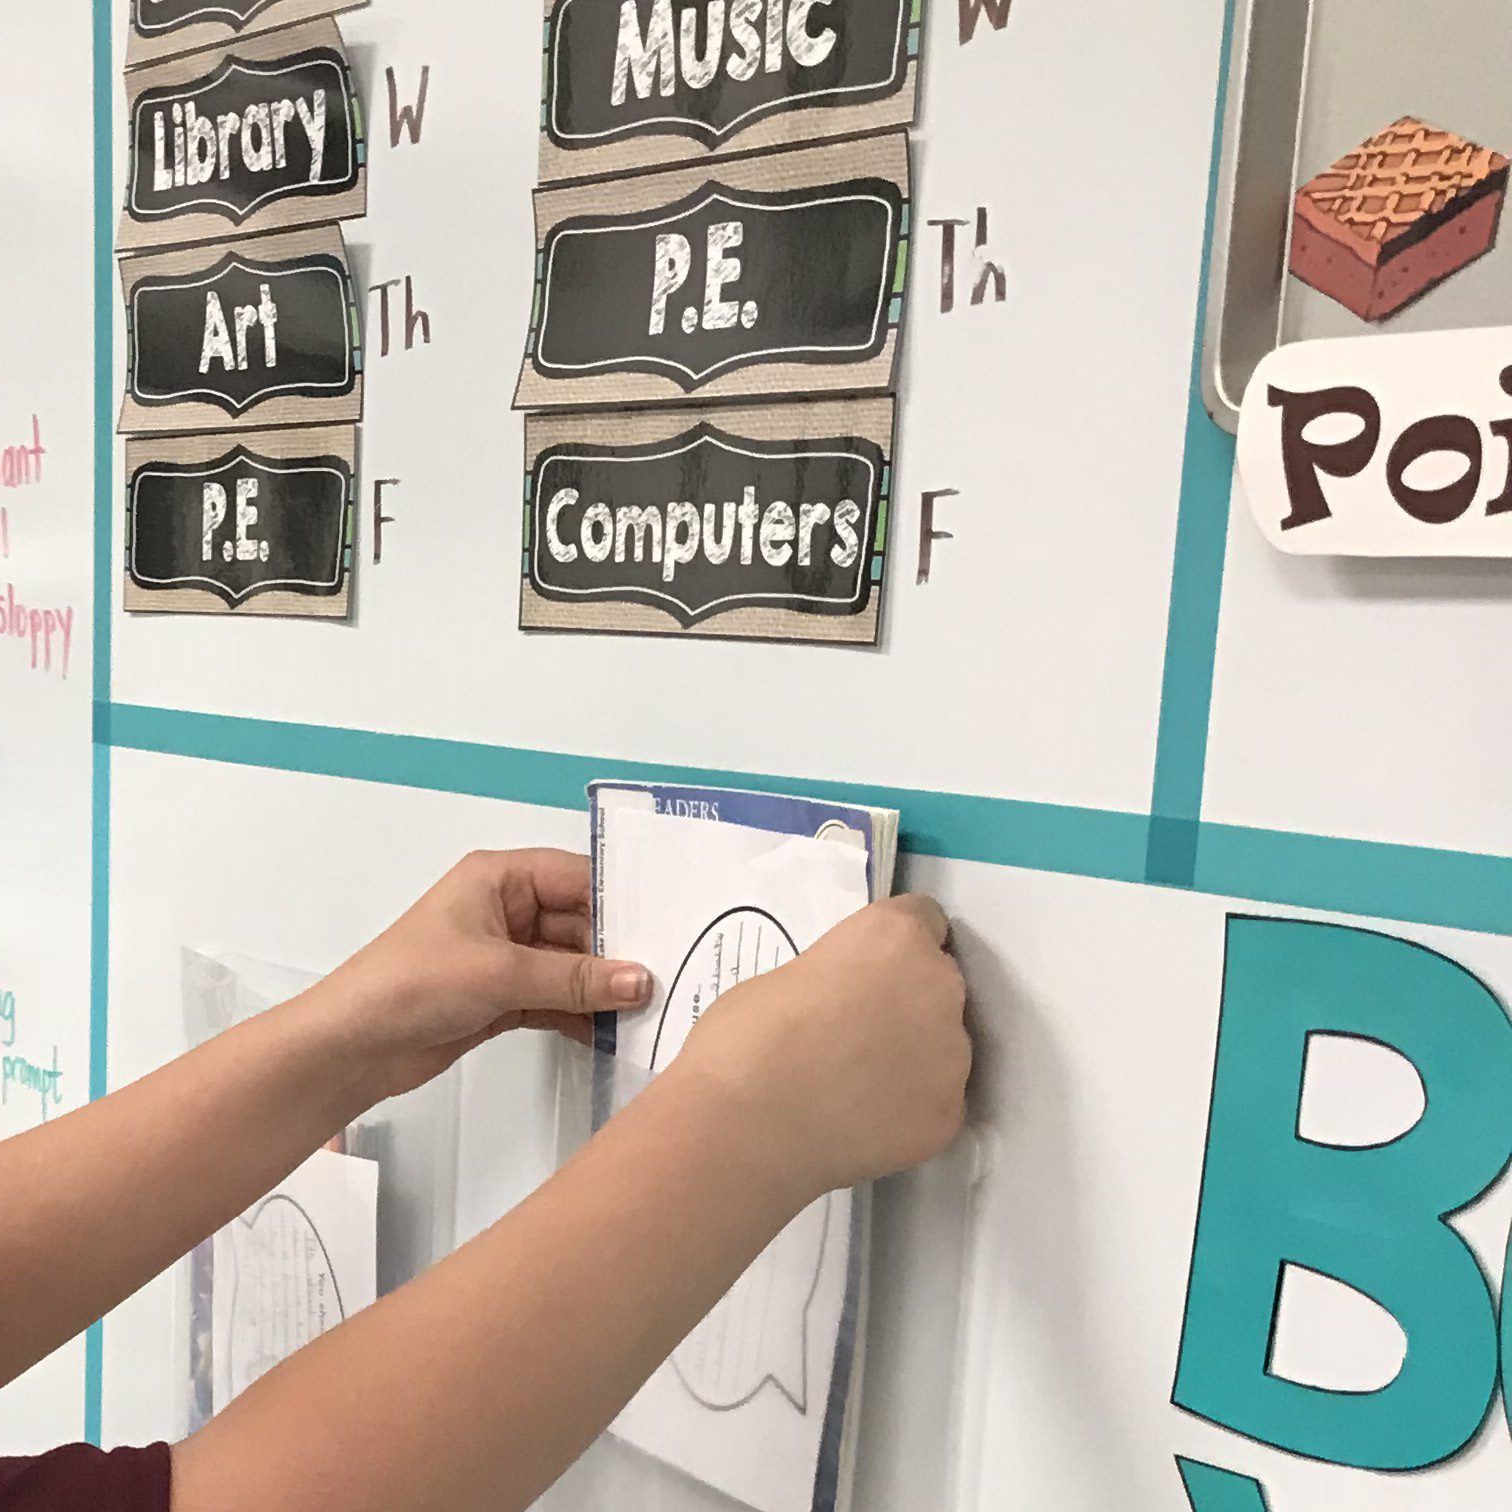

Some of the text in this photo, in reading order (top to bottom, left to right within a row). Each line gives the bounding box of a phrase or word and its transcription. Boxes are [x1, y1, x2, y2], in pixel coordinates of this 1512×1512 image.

[153, 89, 326, 192] Library
[386, 65, 430, 149] W
[647, 222, 760, 336] P.E.
[927, 206, 1007, 314] Th
[198, 283, 279, 374] Art
[369, 275, 431, 357] Th
[1267, 363, 1512, 532] Poi
[201, 478, 270, 563] P.E.
[373, 478, 401, 565] F
[545, 485, 863, 583] Computers
[917, 487, 961, 586] F
[655, 798, 719, 821] EADERS
[2, 1045, 63, 1124] prompt
[1171, 912, 1512, 1475] B
